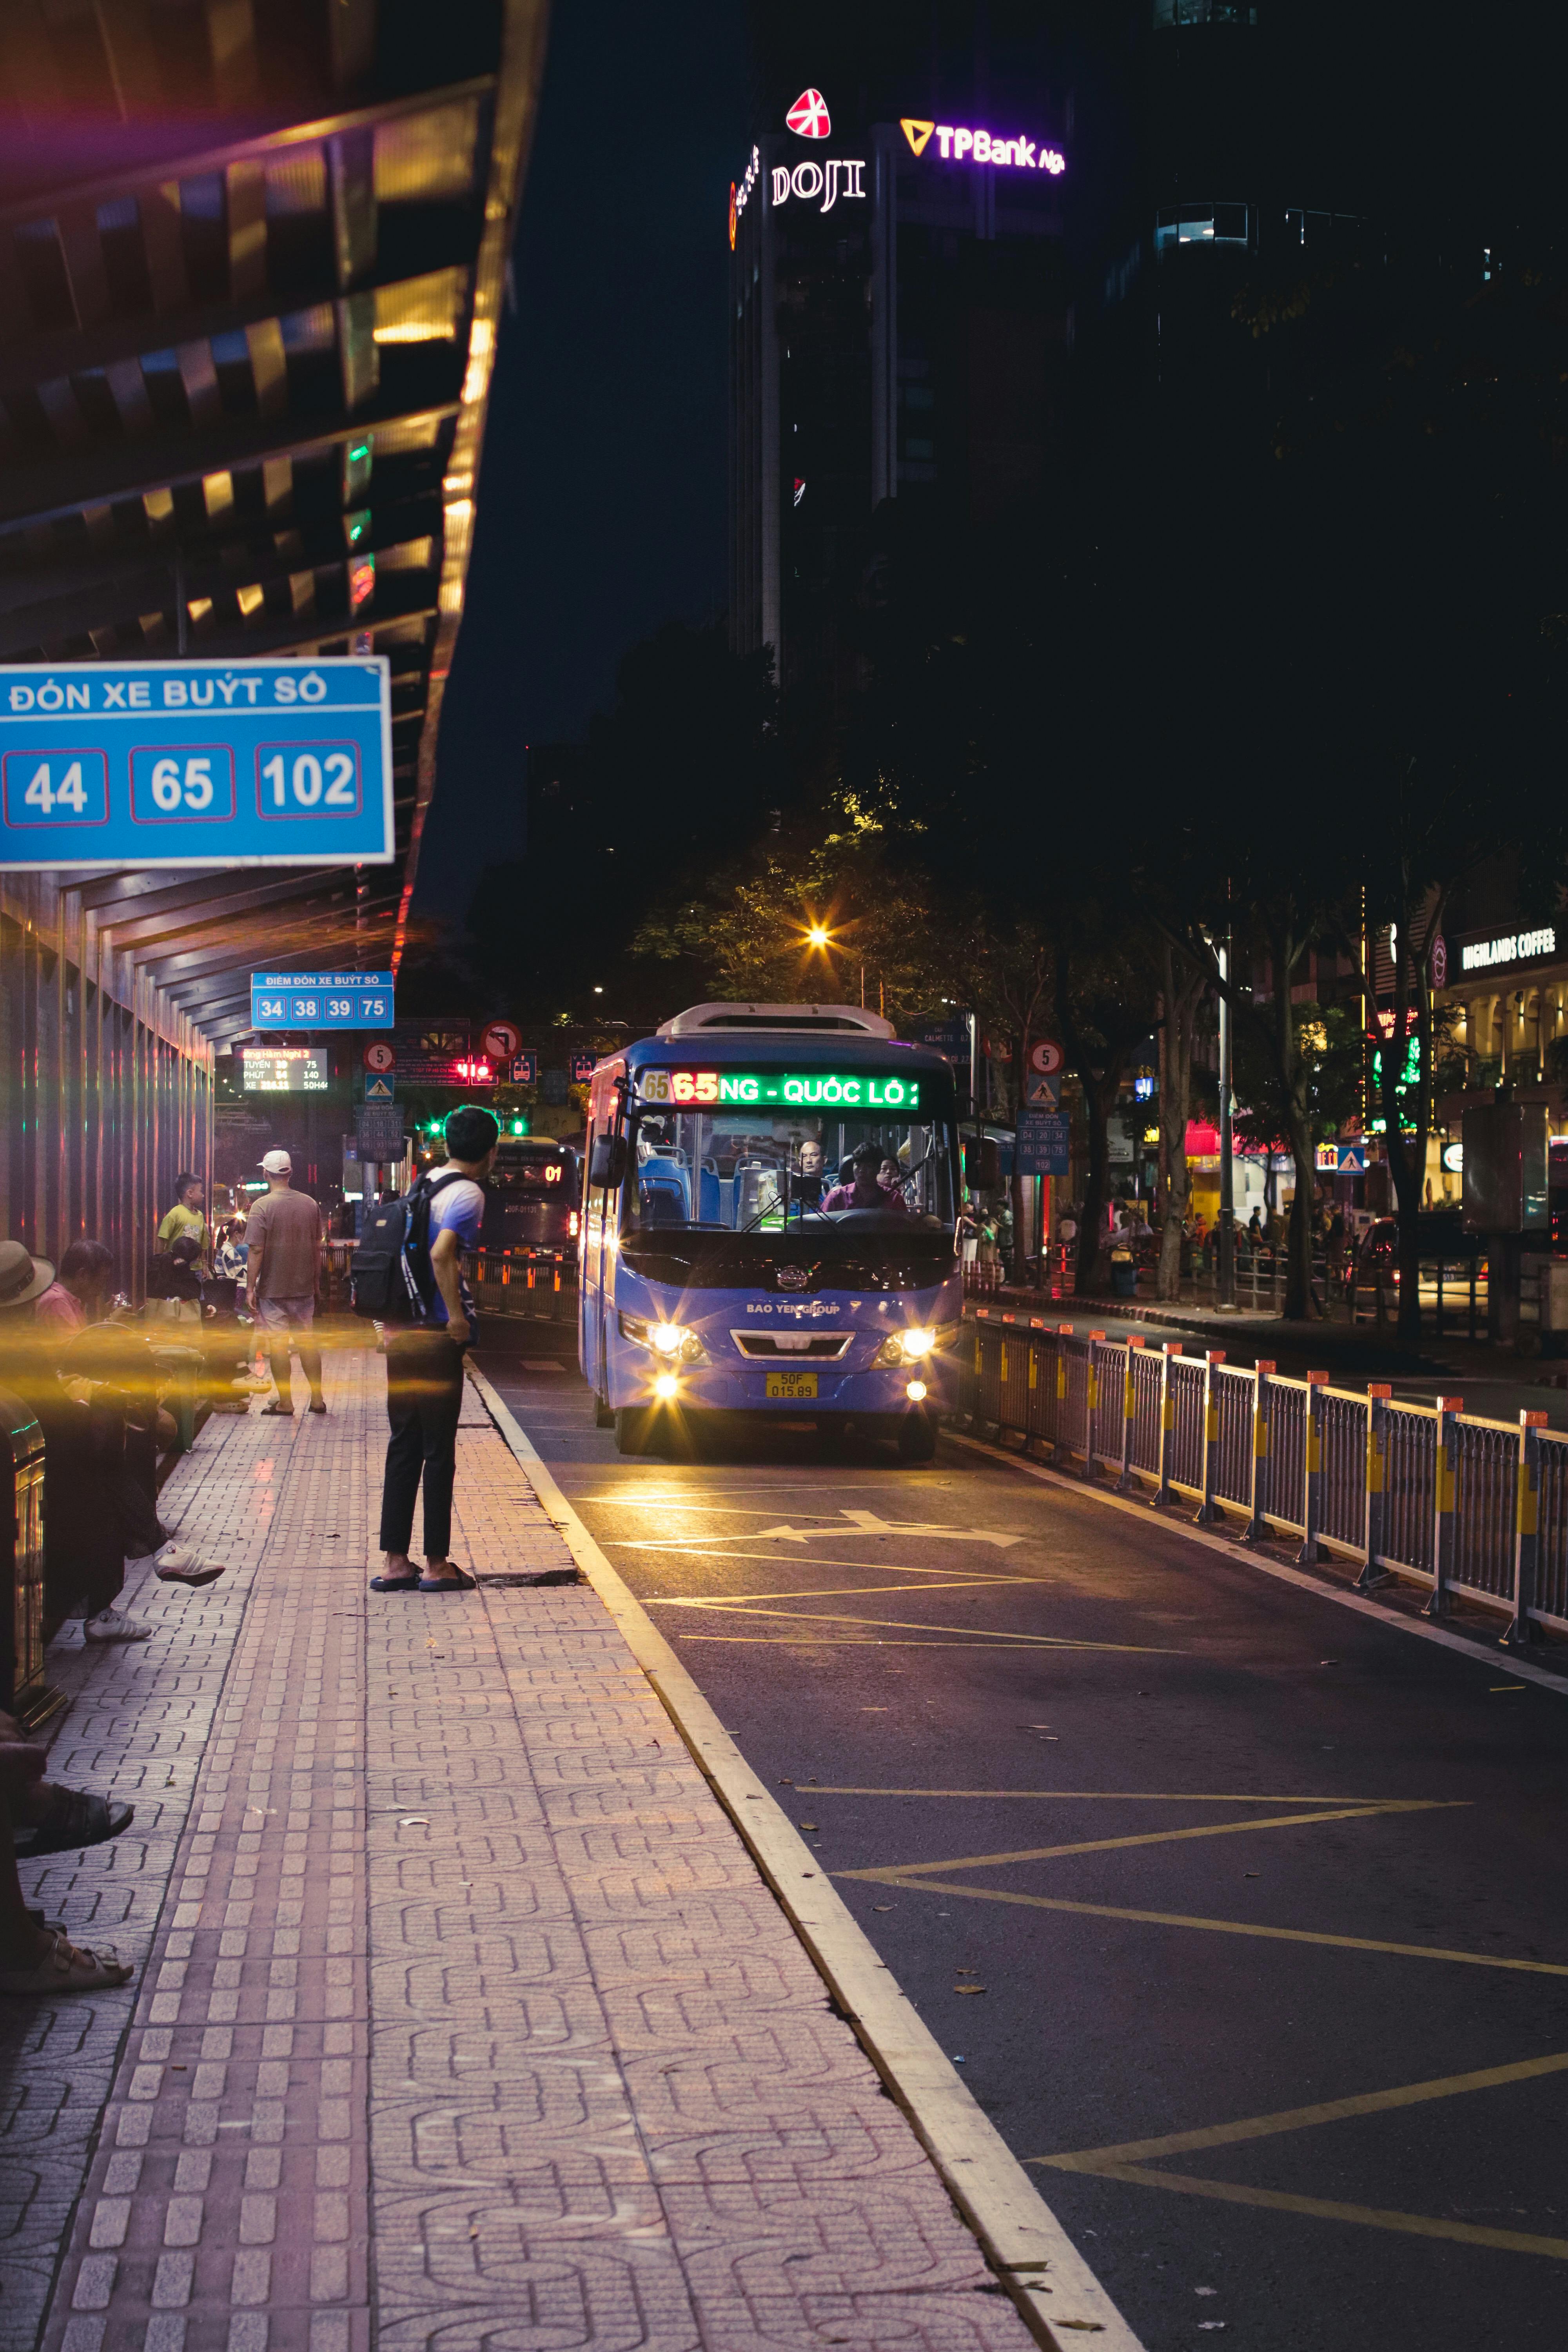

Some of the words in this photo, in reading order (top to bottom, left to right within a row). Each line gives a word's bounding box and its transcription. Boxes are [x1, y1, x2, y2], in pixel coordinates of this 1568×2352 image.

[936, 126, 1036, 168] TPBank
[772, 160, 866, 212] DOJI
[9, 677, 90, 711] ĐÓN
[103, 681, 151, 708] XE
[163, 670, 262, 706] BUÝT
[25, 762, 88, 813] 44
[151, 757, 214, 811] 65
[262, 753, 355, 807] 102
[1463, 935, 1517, 970] HIGHLANDS
[1517, 927, 1556, 958] COFFEE
[294, 975, 316, 985] ĐÓN
[335, 974, 362, 984] BUÝT
[261, 1001, 283, 1016] 34
[295, 1001, 316, 1016] 38
[329, 1000, 350, 1016] 39
[363, 1000, 384, 1016] 75
[376, 1049, 384, 1063] 5
[1042, 1049, 1050, 1066] 5
[645, 1074, 668, 1100] 65
[672, 1073, 718, 1101] 65
[720, 1078, 759, 1100] NG
[545, 1165, 562, 1181] 01
[747, 1304, 773, 1313] BAO
[776, 1305, 798, 1313] YEN
[802, 1305, 840, 1314] GROUP
[781, 1374, 803, 1385] 50F
[772, 1386, 811, 1397] 015.89
